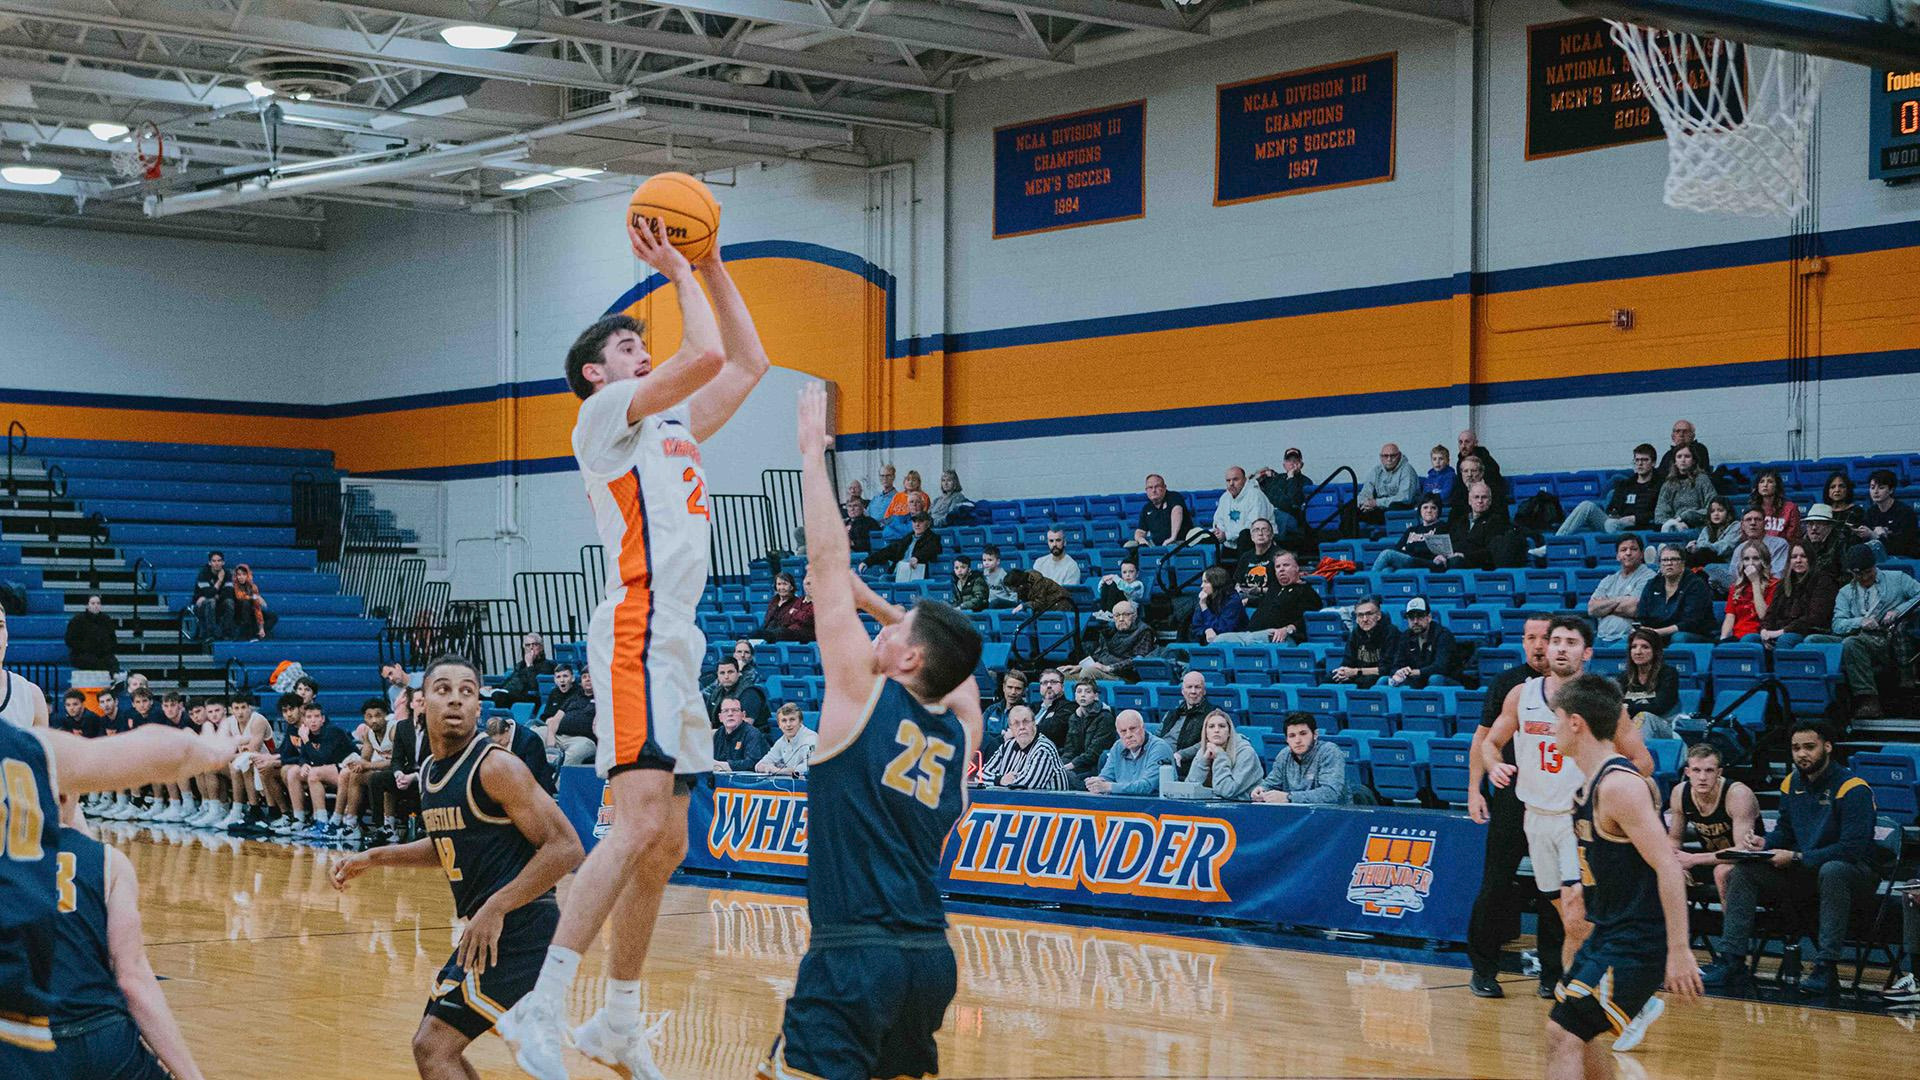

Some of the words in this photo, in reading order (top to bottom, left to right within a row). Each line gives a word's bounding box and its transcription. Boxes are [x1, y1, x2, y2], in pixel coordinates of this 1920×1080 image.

[1560, 32, 1604, 56] NCAA
[1546, 56, 1615, 85] NATIONAL
[1243, 91, 1279, 113] NCAA
[1285, 78, 1344, 105] DIVISION
[1351, 74, 1367, 94] III
[1550, 86, 1602, 112] MEN'S
[1265, 104, 1344, 133] CHAMPIONS
[1614, 106, 1651, 129] 2019
[1016, 132, 1047, 152] NCAA
[1052, 121, 1101, 145] DIVISION
[1108, 118, 1121, 136] III
[1255, 137, 1298, 160] MEN'S
[1304, 128, 1356, 153] SOCCER
[1034, 145, 1102, 172] CHAMPIONS
[1288, 158, 1318, 179] 1997
[1025, 175, 1062, 196] MEN'S
[1067, 168, 1111, 189] SOCCER
[881, 719, 956, 810] 25
[1538, 741, 1563, 774] 13
[1370, 826, 1437, 837] WHEATON
[954, 807, 1230, 891] THUNDER
[1351, 864, 1433, 893] THUNDER
